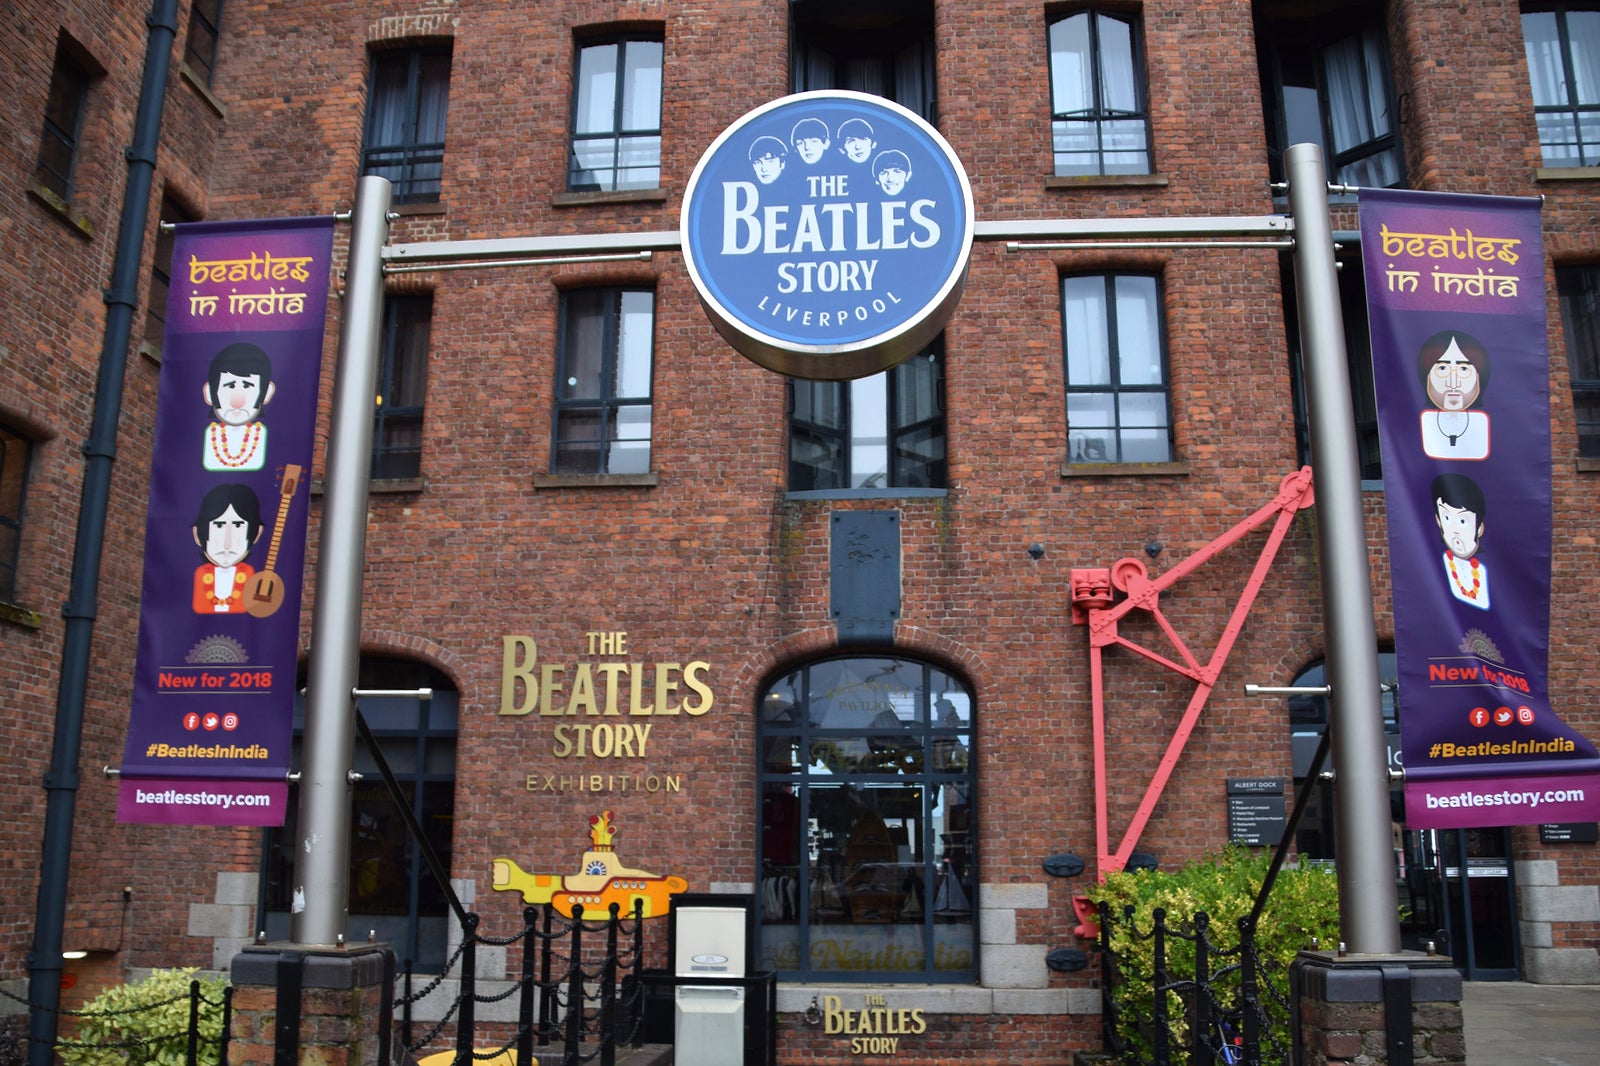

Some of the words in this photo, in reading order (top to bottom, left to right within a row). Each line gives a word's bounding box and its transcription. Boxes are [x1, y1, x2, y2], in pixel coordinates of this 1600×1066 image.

[806, 174, 850, 198] THE
[719, 180, 942, 255] BEATLES
[1379, 223, 1522, 265] beatles
[188, 250, 313, 284] beatles
[776, 259, 879, 294] STORY
[1385, 263, 1421, 293] in
[1431, 264, 1520, 298] india
[189, 290, 219, 317] in
[228, 286, 308, 316] india
[757, 290, 902, 327] LIVERPOOL
[585, 631, 628, 656] THE
[157, 672, 197, 688] New
[200, 672, 225, 688] for
[229, 671, 273, 688] 2018
[498, 634, 714, 716] BEATLES
[1428, 664, 1479, 682] New
[145, 742, 269, 760] #BeatlesInIndia
[552, 723, 653, 758] STORY
[1428, 737, 1575, 759] #BeatlesInIndia
[526, 774, 681, 793] EXHIBITION
[135, 789, 271, 809] beatlesstory.com
[1425, 788, 1585, 809] beatlesstory.com
[810, 938, 974, 971] Nauticlia
[864, 993, 887, 1006] THE
[824, 994, 927, 1035] BEATLES
[851, 1037, 899, 1054] STORY
